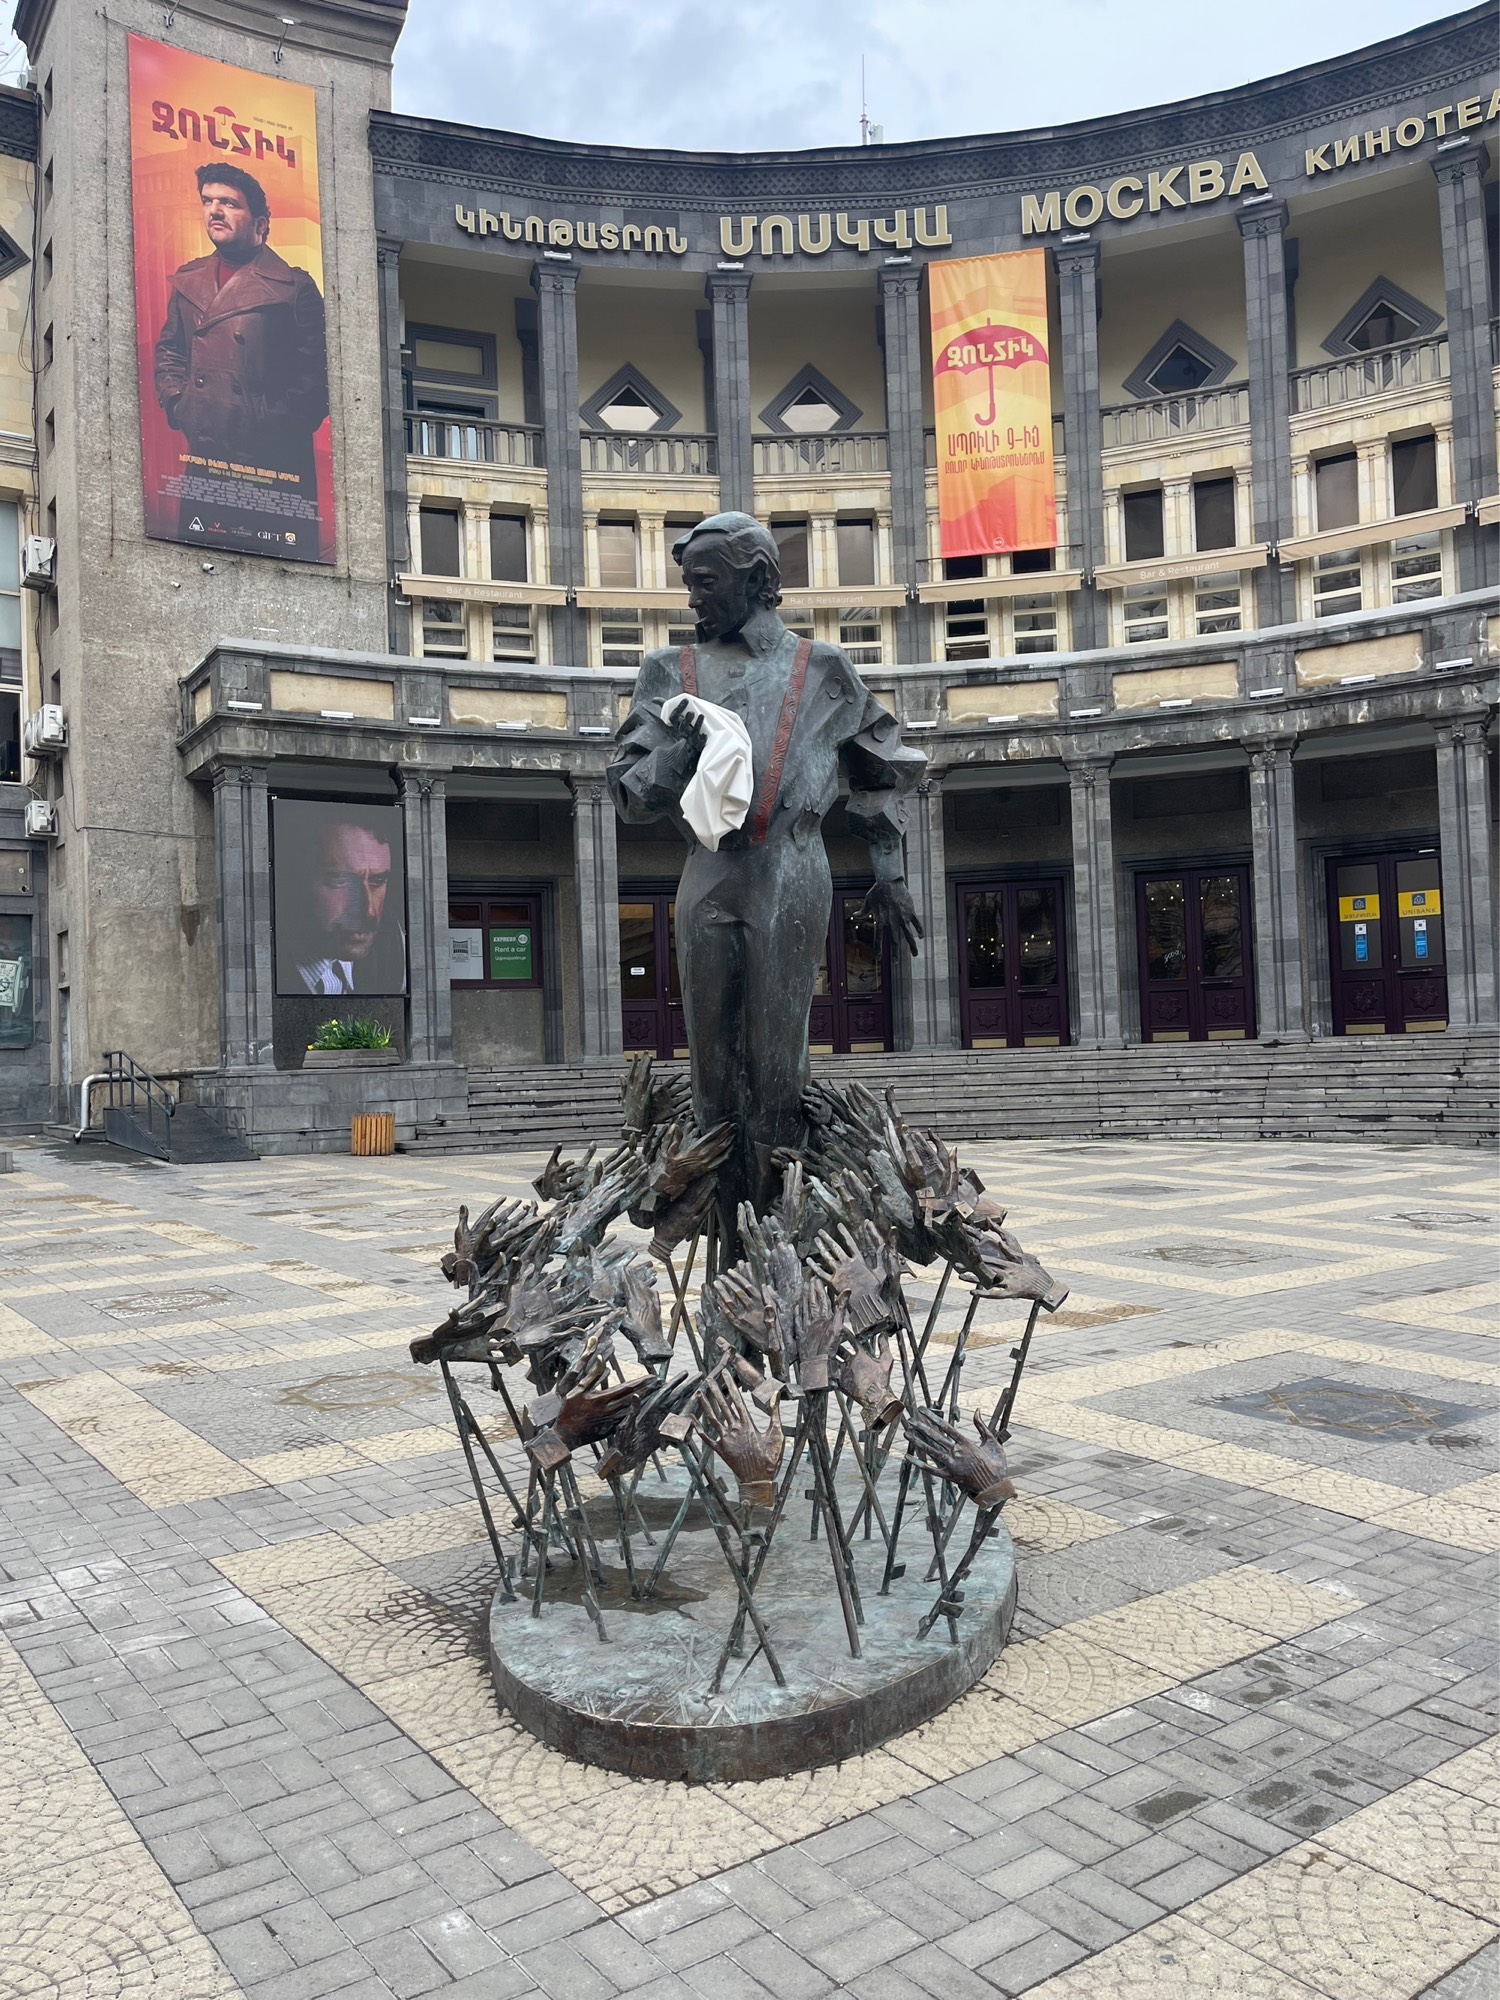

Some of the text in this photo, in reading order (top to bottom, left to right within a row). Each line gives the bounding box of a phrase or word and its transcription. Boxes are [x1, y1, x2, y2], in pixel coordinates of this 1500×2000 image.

[1020, 151, 1269, 235] МОСКВА
[455, 204, 953, 257] ԿԻՆՈԹԱՏՐՈՆ ՄՈՍԿՎԱ
[948, 429, 1000, 457] ԱՊՐԻԼԻ
[1140, 561, 1219, 580] Bar & Restaurant
[446, 586, 523, 599] Bar & Restaurant
[789, 595, 864, 605] Bar & Restaurant
[1402, 908, 1437, 916] UNIBANK
